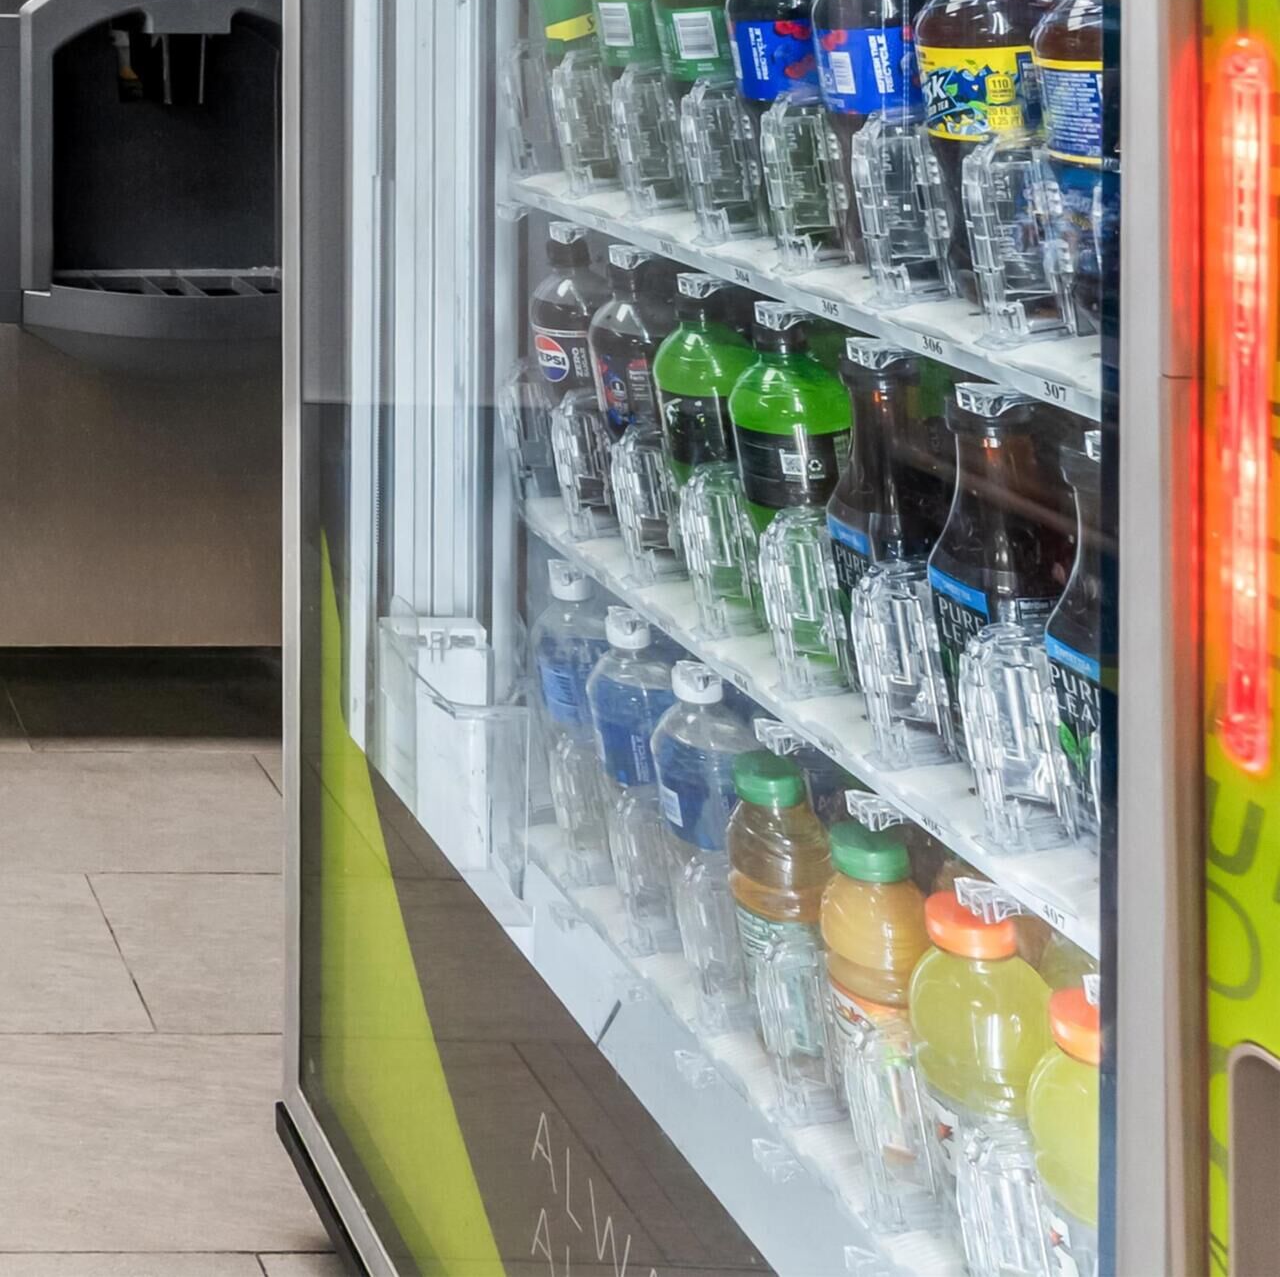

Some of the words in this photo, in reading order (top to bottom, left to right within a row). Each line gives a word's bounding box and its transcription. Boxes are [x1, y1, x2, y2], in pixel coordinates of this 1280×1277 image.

[992, 78, 1009, 89] 110
[734, 267, 750, 283] 304
[822, 299, 840, 317] 305
[922, 335, 943, 356] 306
[539, 351, 567, 368] EPSI
[571, 346, 584, 379] ZERO
[1044, 380, 1066, 403] 307
[1056, 688, 1098, 728] LEA
[1043, 904, 1066, 930] 407
[531, 1112, 655, 1277] ALW
